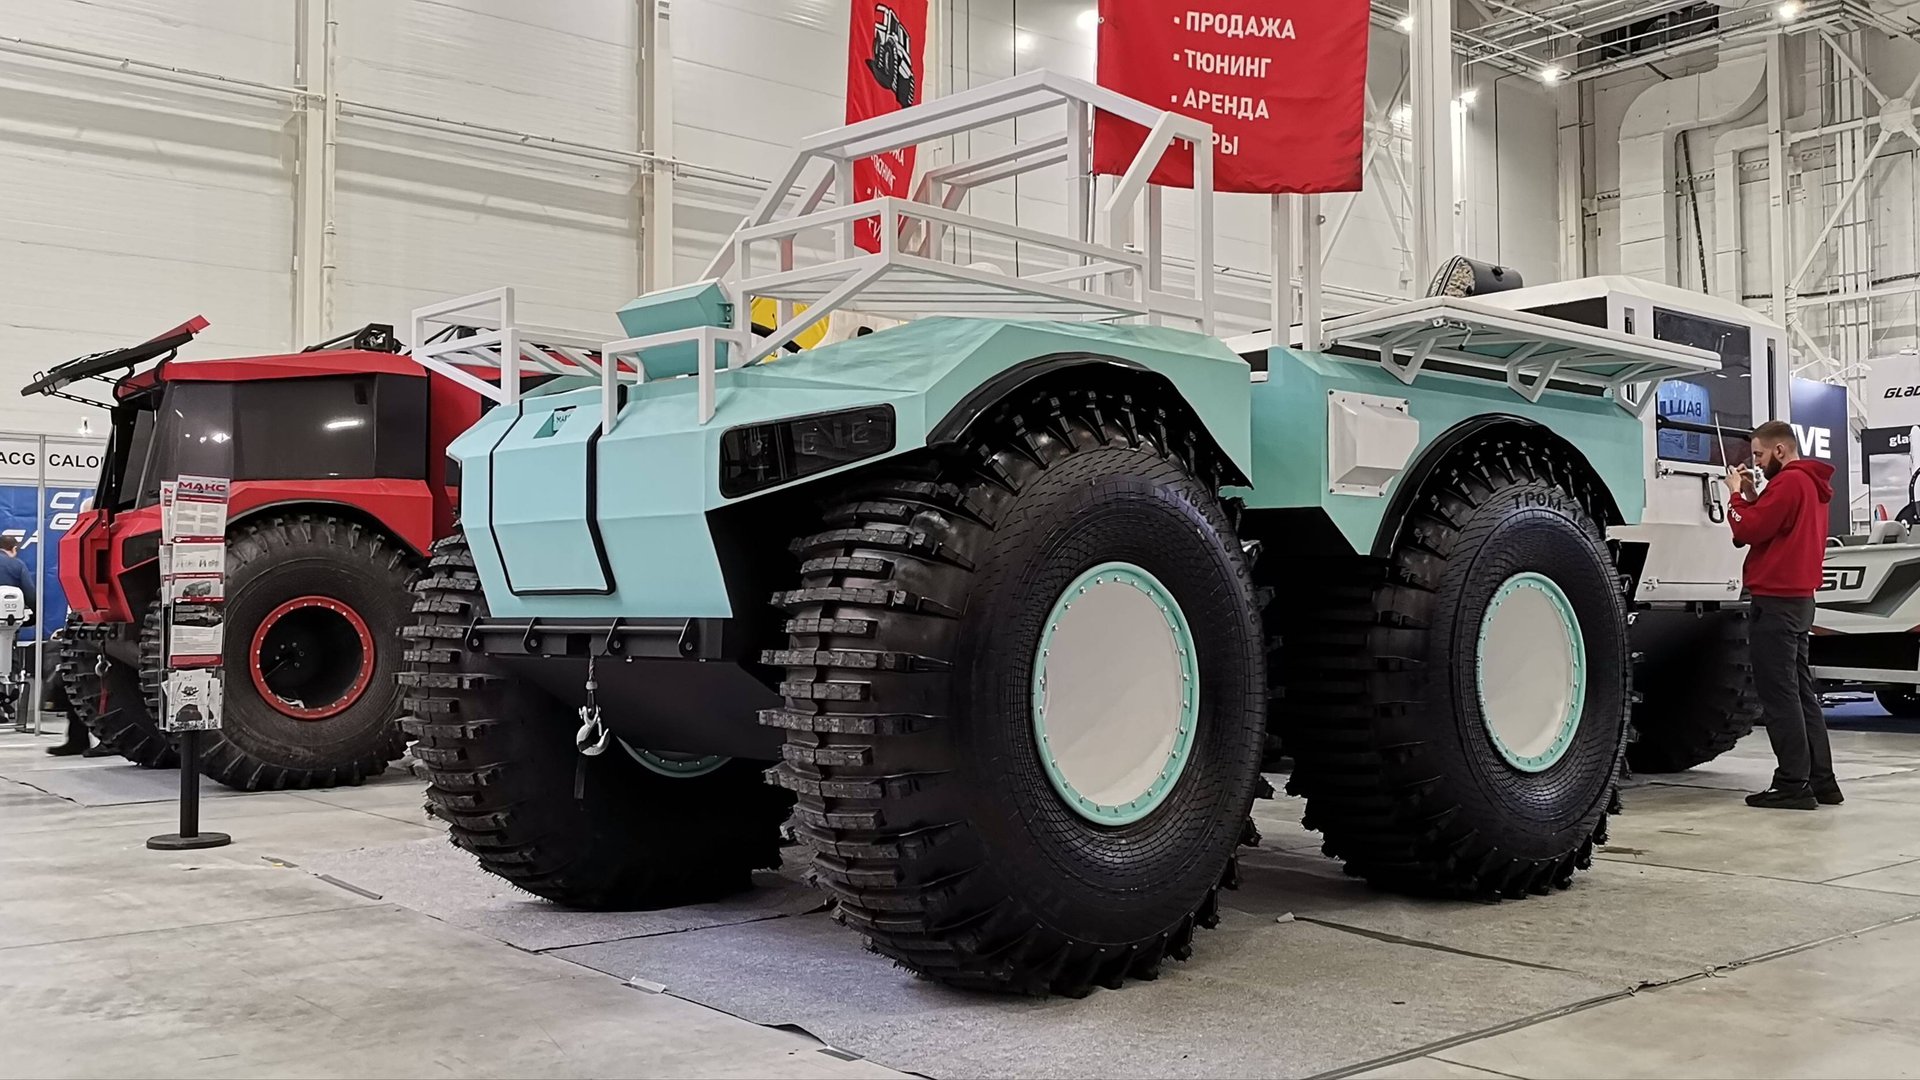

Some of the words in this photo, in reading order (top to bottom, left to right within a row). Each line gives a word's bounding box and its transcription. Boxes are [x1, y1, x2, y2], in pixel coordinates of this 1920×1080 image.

[1186, 11, 1296, 39] ПРОДАЖА
[1184, 49, 1272, 78] ТЮНИНГ
[1182, 87, 1269, 121] АРЕНДА
[1791, 424, 1831, 459] VE
[1889, 434, 1912, 447] gla
[49, 453, 104, 468] CALO
